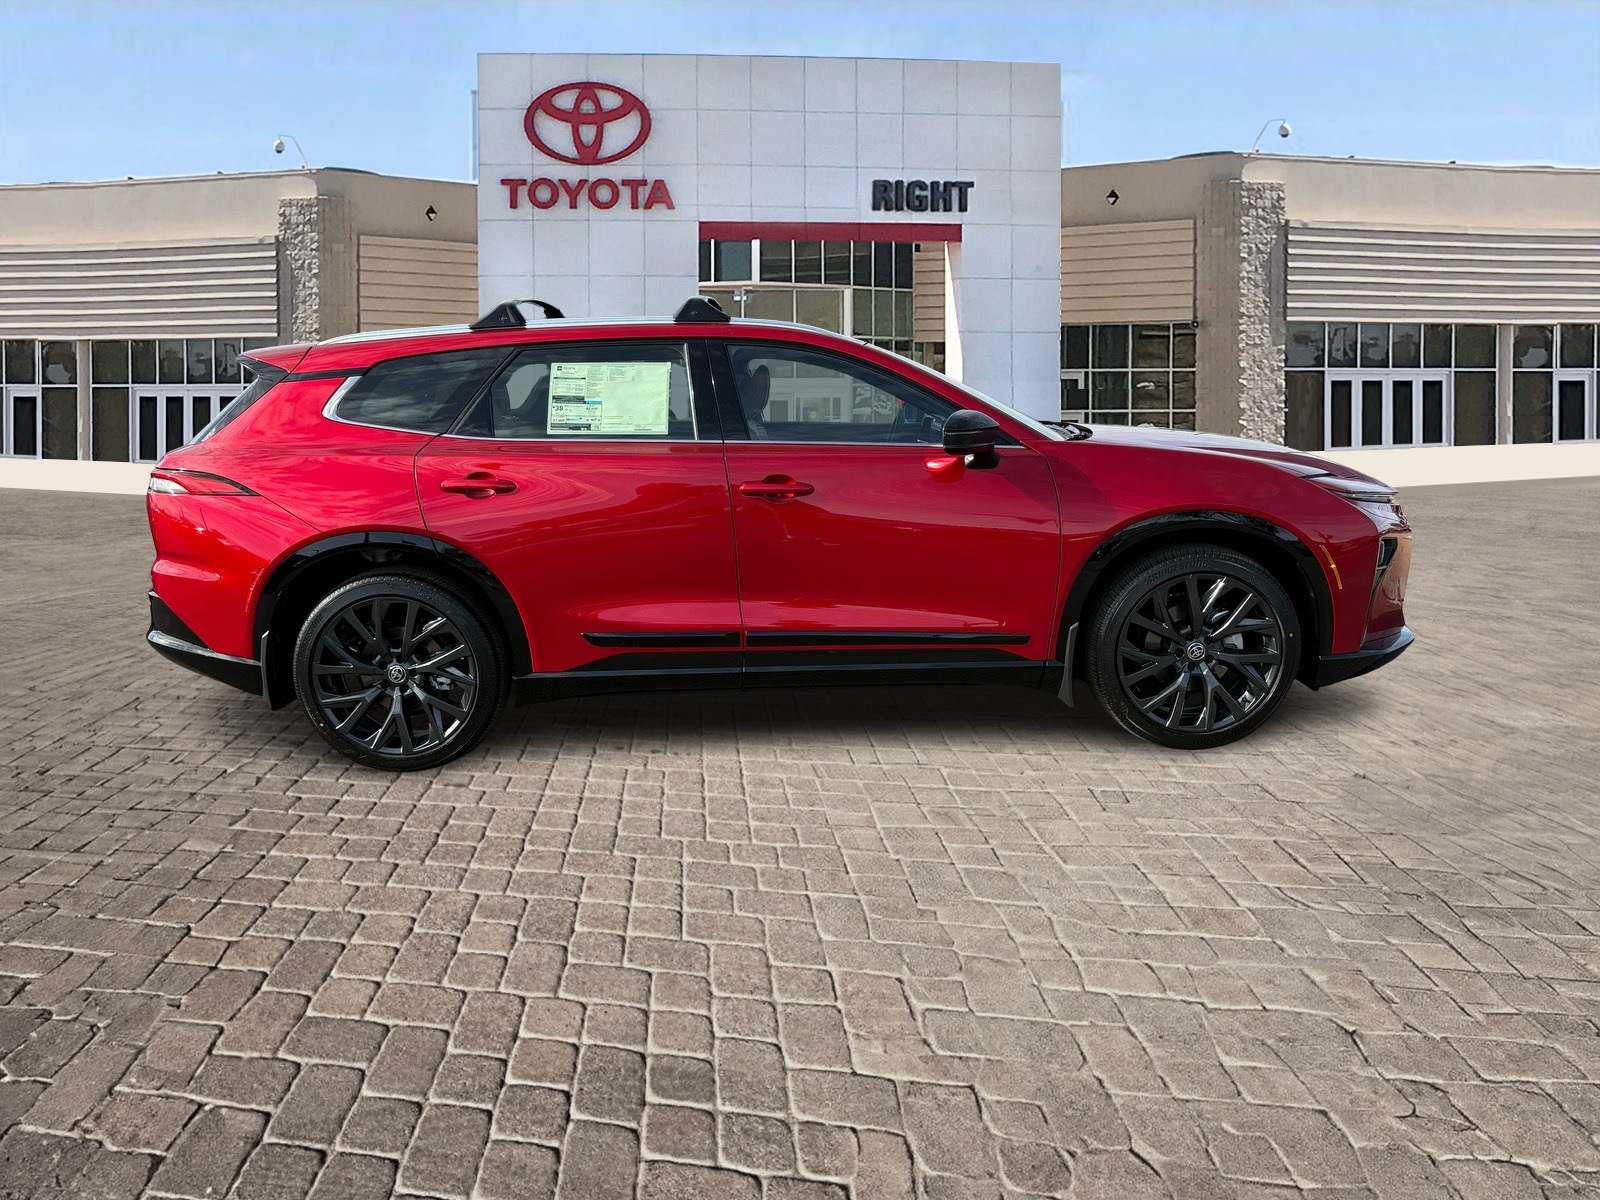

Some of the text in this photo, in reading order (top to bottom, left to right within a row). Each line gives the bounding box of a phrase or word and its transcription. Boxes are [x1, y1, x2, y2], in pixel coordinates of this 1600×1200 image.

[500, 178, 676, 210] TOYOTA
[872, 180, 974, 212] RIGHT
[1144, 560, 1209, 585] BRIDGESTONE
